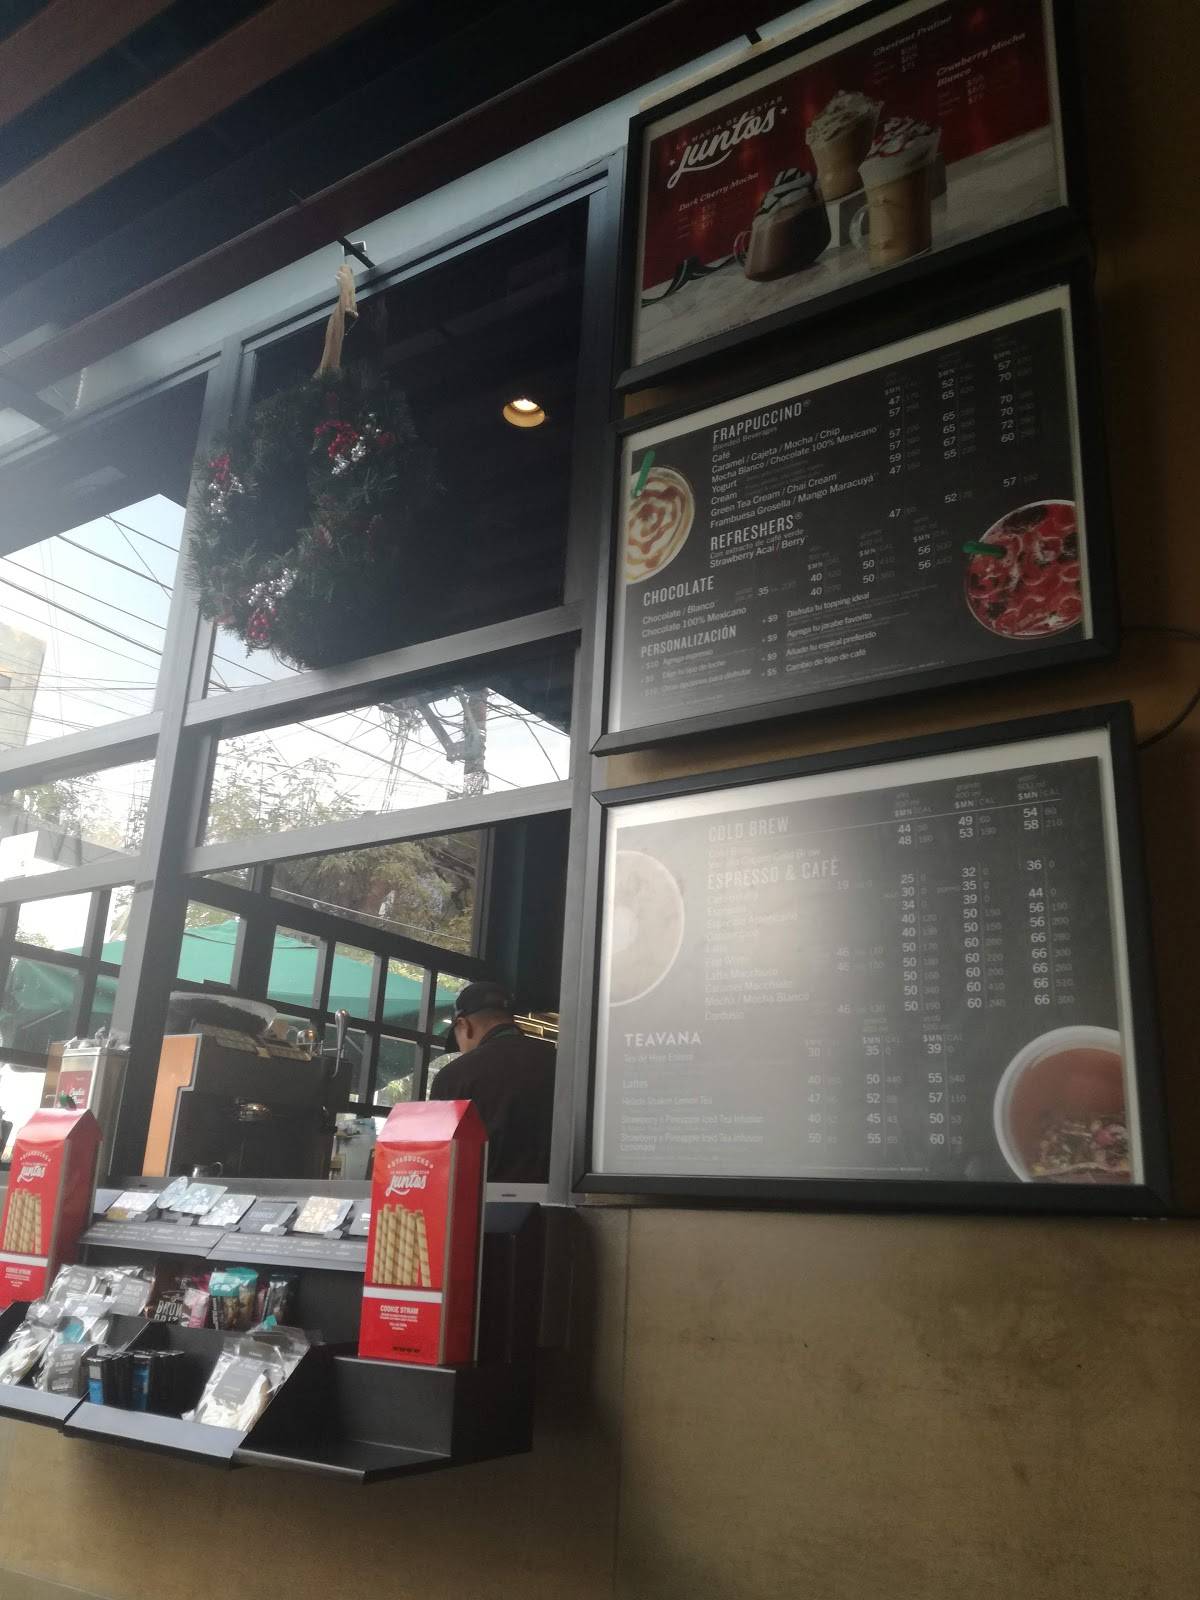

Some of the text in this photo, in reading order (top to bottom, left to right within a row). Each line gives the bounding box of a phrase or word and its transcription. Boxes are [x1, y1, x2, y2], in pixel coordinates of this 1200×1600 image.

[666, 106, 777, 190] juntos
[998, 371, 1012, 383] 70
[942, 388, 955, 401] 65
[999, 392, 1013, 405] 70
[888, 405, 901, 417] 57
[942, 410, 955, 422] 65
[1000, 405, 1013, 418] 70
[888, 426, 901, 438] 57
[943, 422, 956, 435] 65
[712, 456, 744, 474] Caramel
[751, 445, 777, 462] Cajeta
[784, 433, 812, 451] Mocha
[819, 425, 840, 440] Chip
[889, 438, 901, 451] 57
[711, 468, 736, 483] Mocha
[738, 460, 764, 475] Blanco
[770, 446, 809, 465] Chocolate
[812, 438, 834, 452] 100%
[711, 479, 737, 495] Yogurt
[1002, 477, 1016, 489] 57
[710, 502, 734, 517] Green
[737, 497, 750, 509] Tea
[753, 489, 779, 504] Cream
[786, 480, 806, 494] Chai
[711, 490, 737, 505] Cream
[944, 492, 957, 505] 52
[710, 509, 754, 528] Frambuesa
[757, 498, 790, 515] Grosella
[799, 486, 827, 504] Mango
[889, 507, 901, 519] 47
[917, 543, 931, 556] 56
[709, 549, 753, 569] Strawberry
[862, 558, 874, 570] 50
[917, 558, 931, 570] 56
[810, 571, 822, 583] 40
[862, 572, 875, 584] 50
[643, 574, 714, 607] CHOCOLATE
[810, 586, 822, 597] 40
[642, 599, 715, 625] Chocolate Blanco
[642, 604, 746, 638] Chocolate 100% Mexicano
[640, 622, 736, 658] PERSONALIZACIÓN
[1023, 806, 1039, 818] 54
[958, 814, 974, 826] 49
[1023, 818, 1039, 831] 58
[708, 815, 789, 843] COLD BREW
[897, 823, 912, 834] 44
[958, 826, 974, 839] 53
[898, 834, 912, 846] 48
[1026, 858, 1042, 871] 36
[707, 865, 778, 890] ESPRESSO
[785, 864, 795, 881] &
[801, 854, 839, 879] CAFÉ
[960, 866, 976, 878] 32
[899, 873, 914, 885] 25
[960, 879, 977, 891] 35
[899, 886, 914, 897] 30
[1027, 886, 1044, 898] 44
[900, 899, 914, 910] 34
[961, 893, 977, 904] 39
[962, 907, 978, 919] 50
[1028, 901, 1045, 913] 56
[900, 913, 915, 925] 40
[1029, 915, 1045, 927] 56
[900, 927, 915, 938] 40
[962, 921, 979, 933] 50
[963, 936, 979, 949] 60
[1030, 930, 1046, 943] 66
[901, 942, 916, 954] 50
[1031, 946, 1047, 959] 66
[901, 957, 916, 968] 50
[964, 952, 980, 964] 60
[964, 966, 981, 978] 60
[1032, 961, 1048, 973] 66
[902, 971, 917, 982] 50
[1032, 976, 1049, 989] 66
[902, 985, 917, 997] 50
[965, 981, 981, 993] 60
[966, 997, 982, 1009] 60
[1033, 993, 1050, 1005] 66
[902, 1001, 918, 1013] 50
[623, 1029, 702, 1048] TEAVANA
[865, 1045, 879, 1055] 35
[926, 1043, 942, 1054] 39
[865, 1073, 880, 1084] 50
[927, 1072, 943, 1083] 55
[866, 1092, 880, 1103] 52
[928, 1092, 944, 1103] 57
[866, 1112, 880, 1124] 45
[929, 1112, 945, 1124] 50
[866, 1132, 881, 1144] 55
[929, 1133, 945, 1145] 60
[390, 1154, 429, 1168] STARBUCKS
[385, 1172, 427, 1198] juntos
